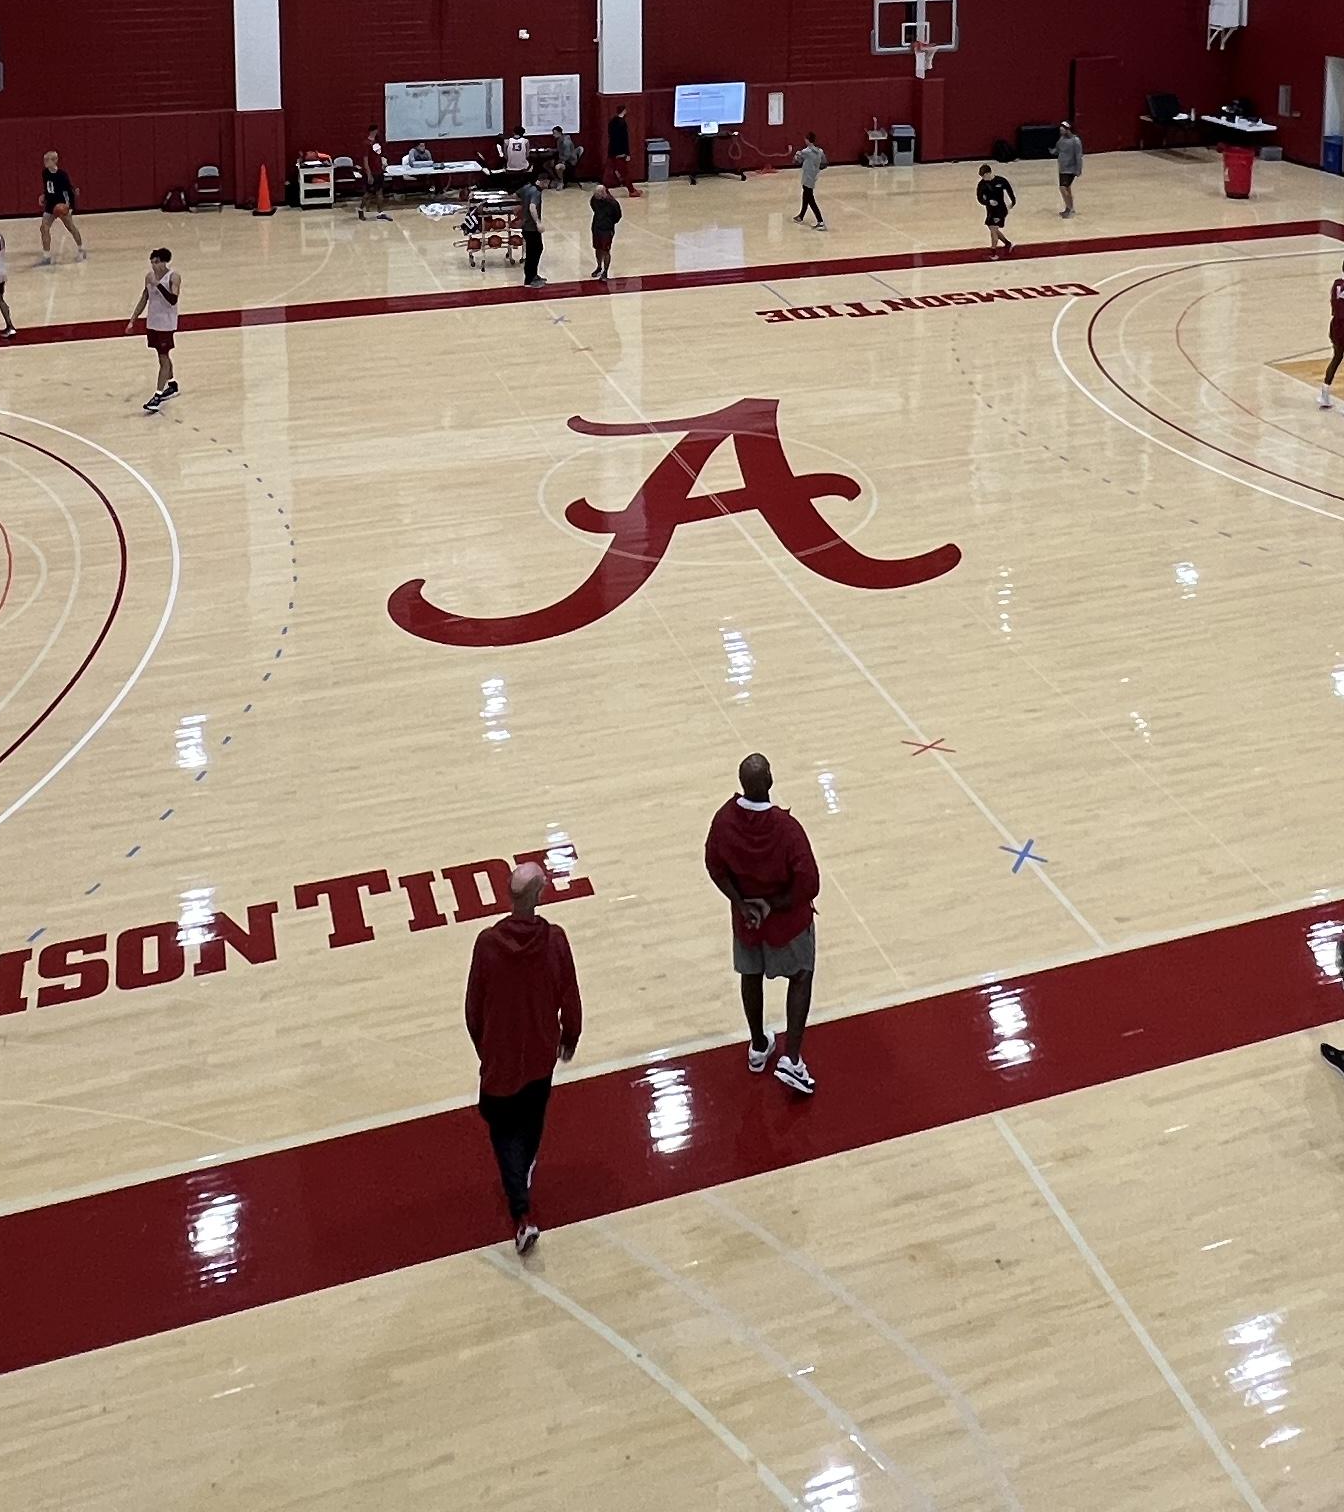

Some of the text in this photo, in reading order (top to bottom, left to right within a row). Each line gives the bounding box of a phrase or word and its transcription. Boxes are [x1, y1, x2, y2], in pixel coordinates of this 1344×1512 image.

[756, 283, 1100, 324] CRIMSON TIDE
[386, 397, 963, 648] A
[294, 845, 595, 948] TIDE
